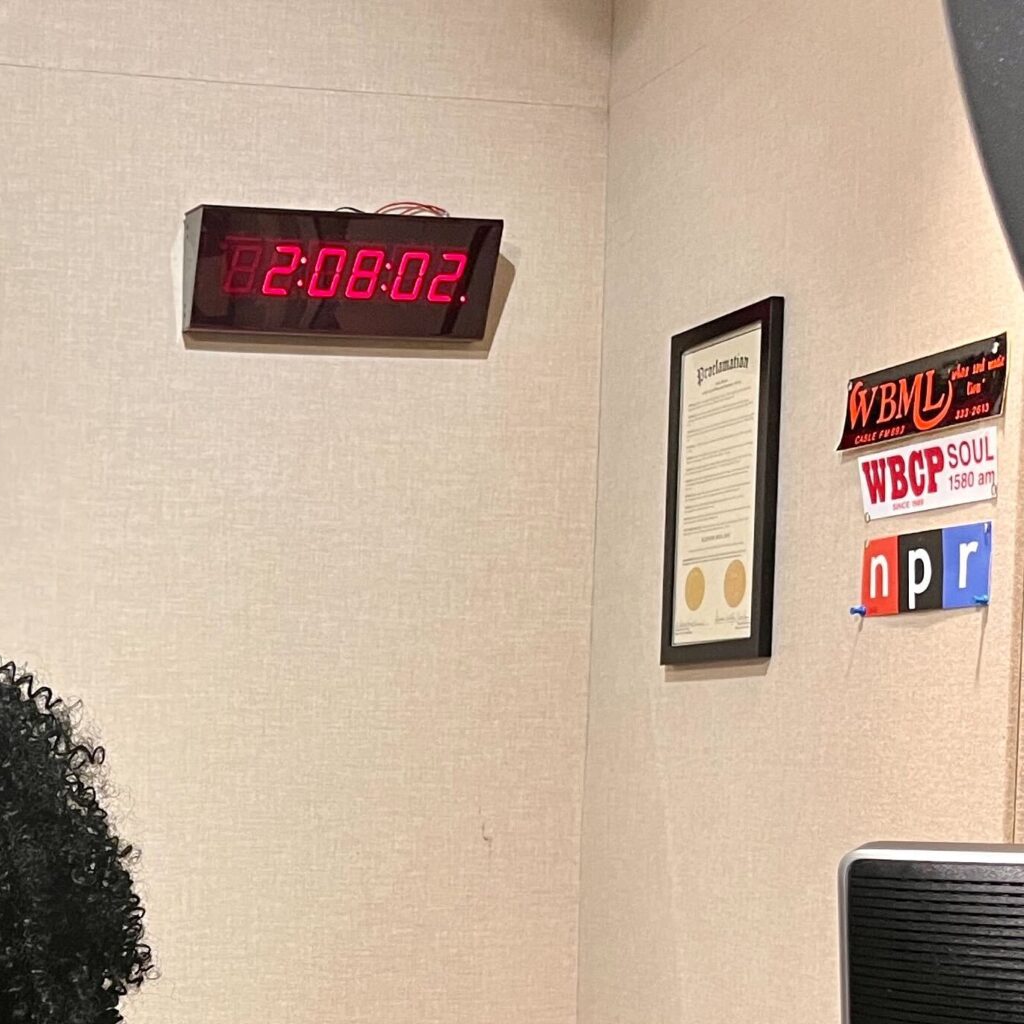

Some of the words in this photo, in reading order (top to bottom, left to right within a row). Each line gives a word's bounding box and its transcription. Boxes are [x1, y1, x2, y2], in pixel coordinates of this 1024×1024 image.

[697, 355, 749, 387] Proclamation
[849, 369, 953, 431] WBML
[947, 435, 994, 469] SOUL
[861, 446, 944, 505] WBCP
[948, 471, 975, 491] 1580
[978, 470, 995, 485] am
[869, 541, 979, 610] npr
